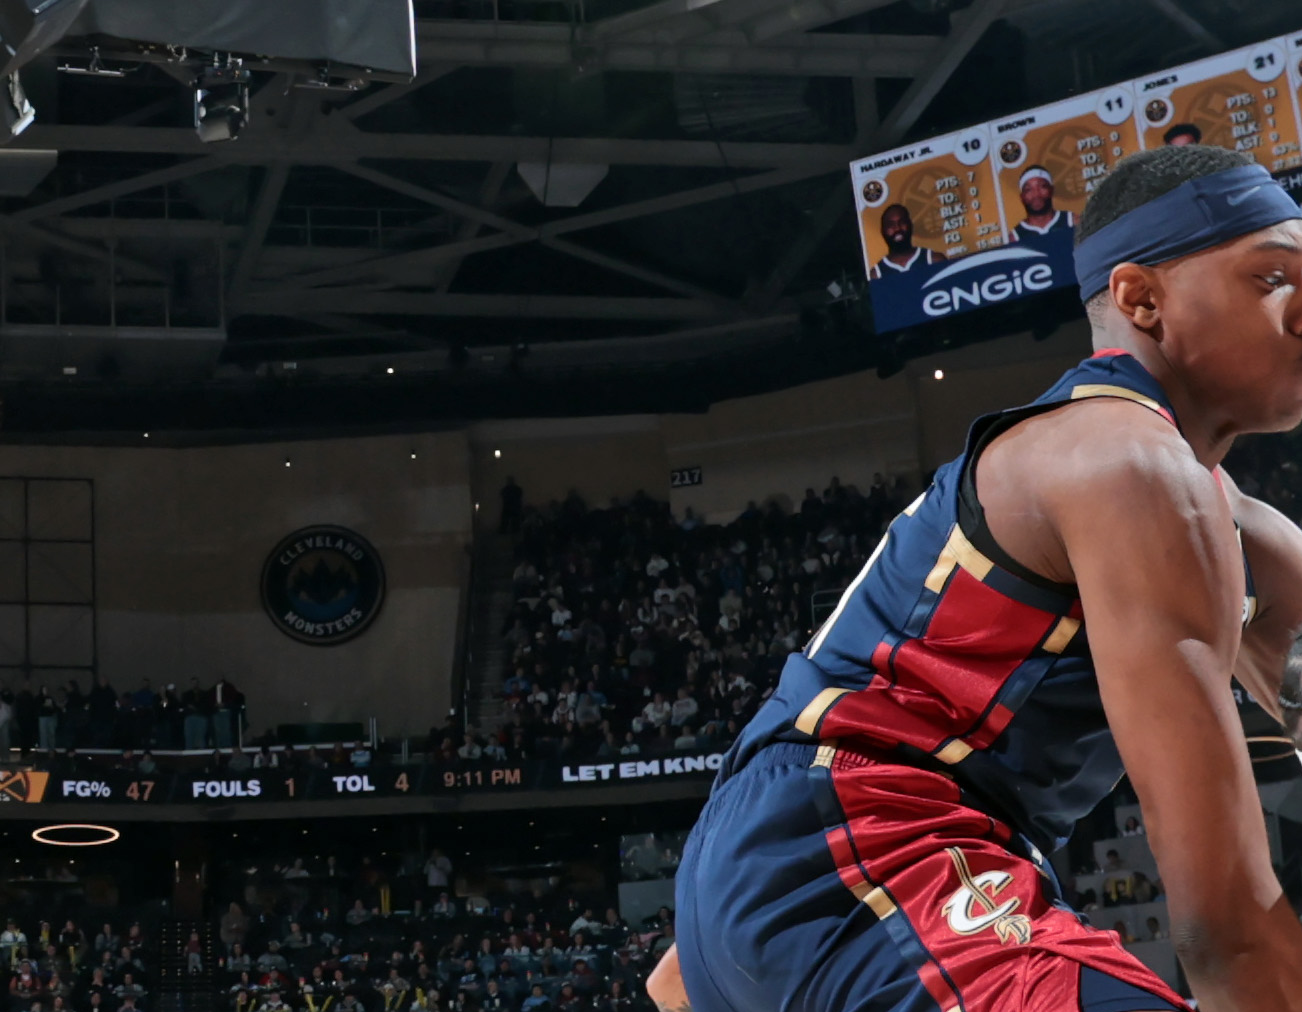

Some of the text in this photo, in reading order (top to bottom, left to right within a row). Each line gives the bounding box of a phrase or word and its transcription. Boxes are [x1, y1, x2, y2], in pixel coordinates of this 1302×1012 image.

[1143, 53, 1275, 92] JONES 21
[997, 97, 1123, 133] BROWN 11
[962, 138, 981, 153] 10
[1110, 131, 1120, 142] 0
[1113, 146, 1122, 157] 0
[860, 151, 916, 173] HARDAWAY
[935, 171, 975, 191] PTS: 7
[969, 186, 978, 197] 0
[940, 200, 980, 218] BLK: 0
[943, 216, 969, 232] AST:
[944, 231, 961, 244] FG
[671, 469, 700, 485] 217
[280, 535, 365, 566] CLEVELAND
[284, 607, 363, 636] MONSTERS
[443, 768, 521, 788] 9:11 PM
[562, 764, 615, 782] LET
[619, 759, 660, 779] EM
[62, 780, 155, 801] FG% 47
[192, 778, 295, 798] FOULS 1
[332, 773, 409, 793] TOL 4
